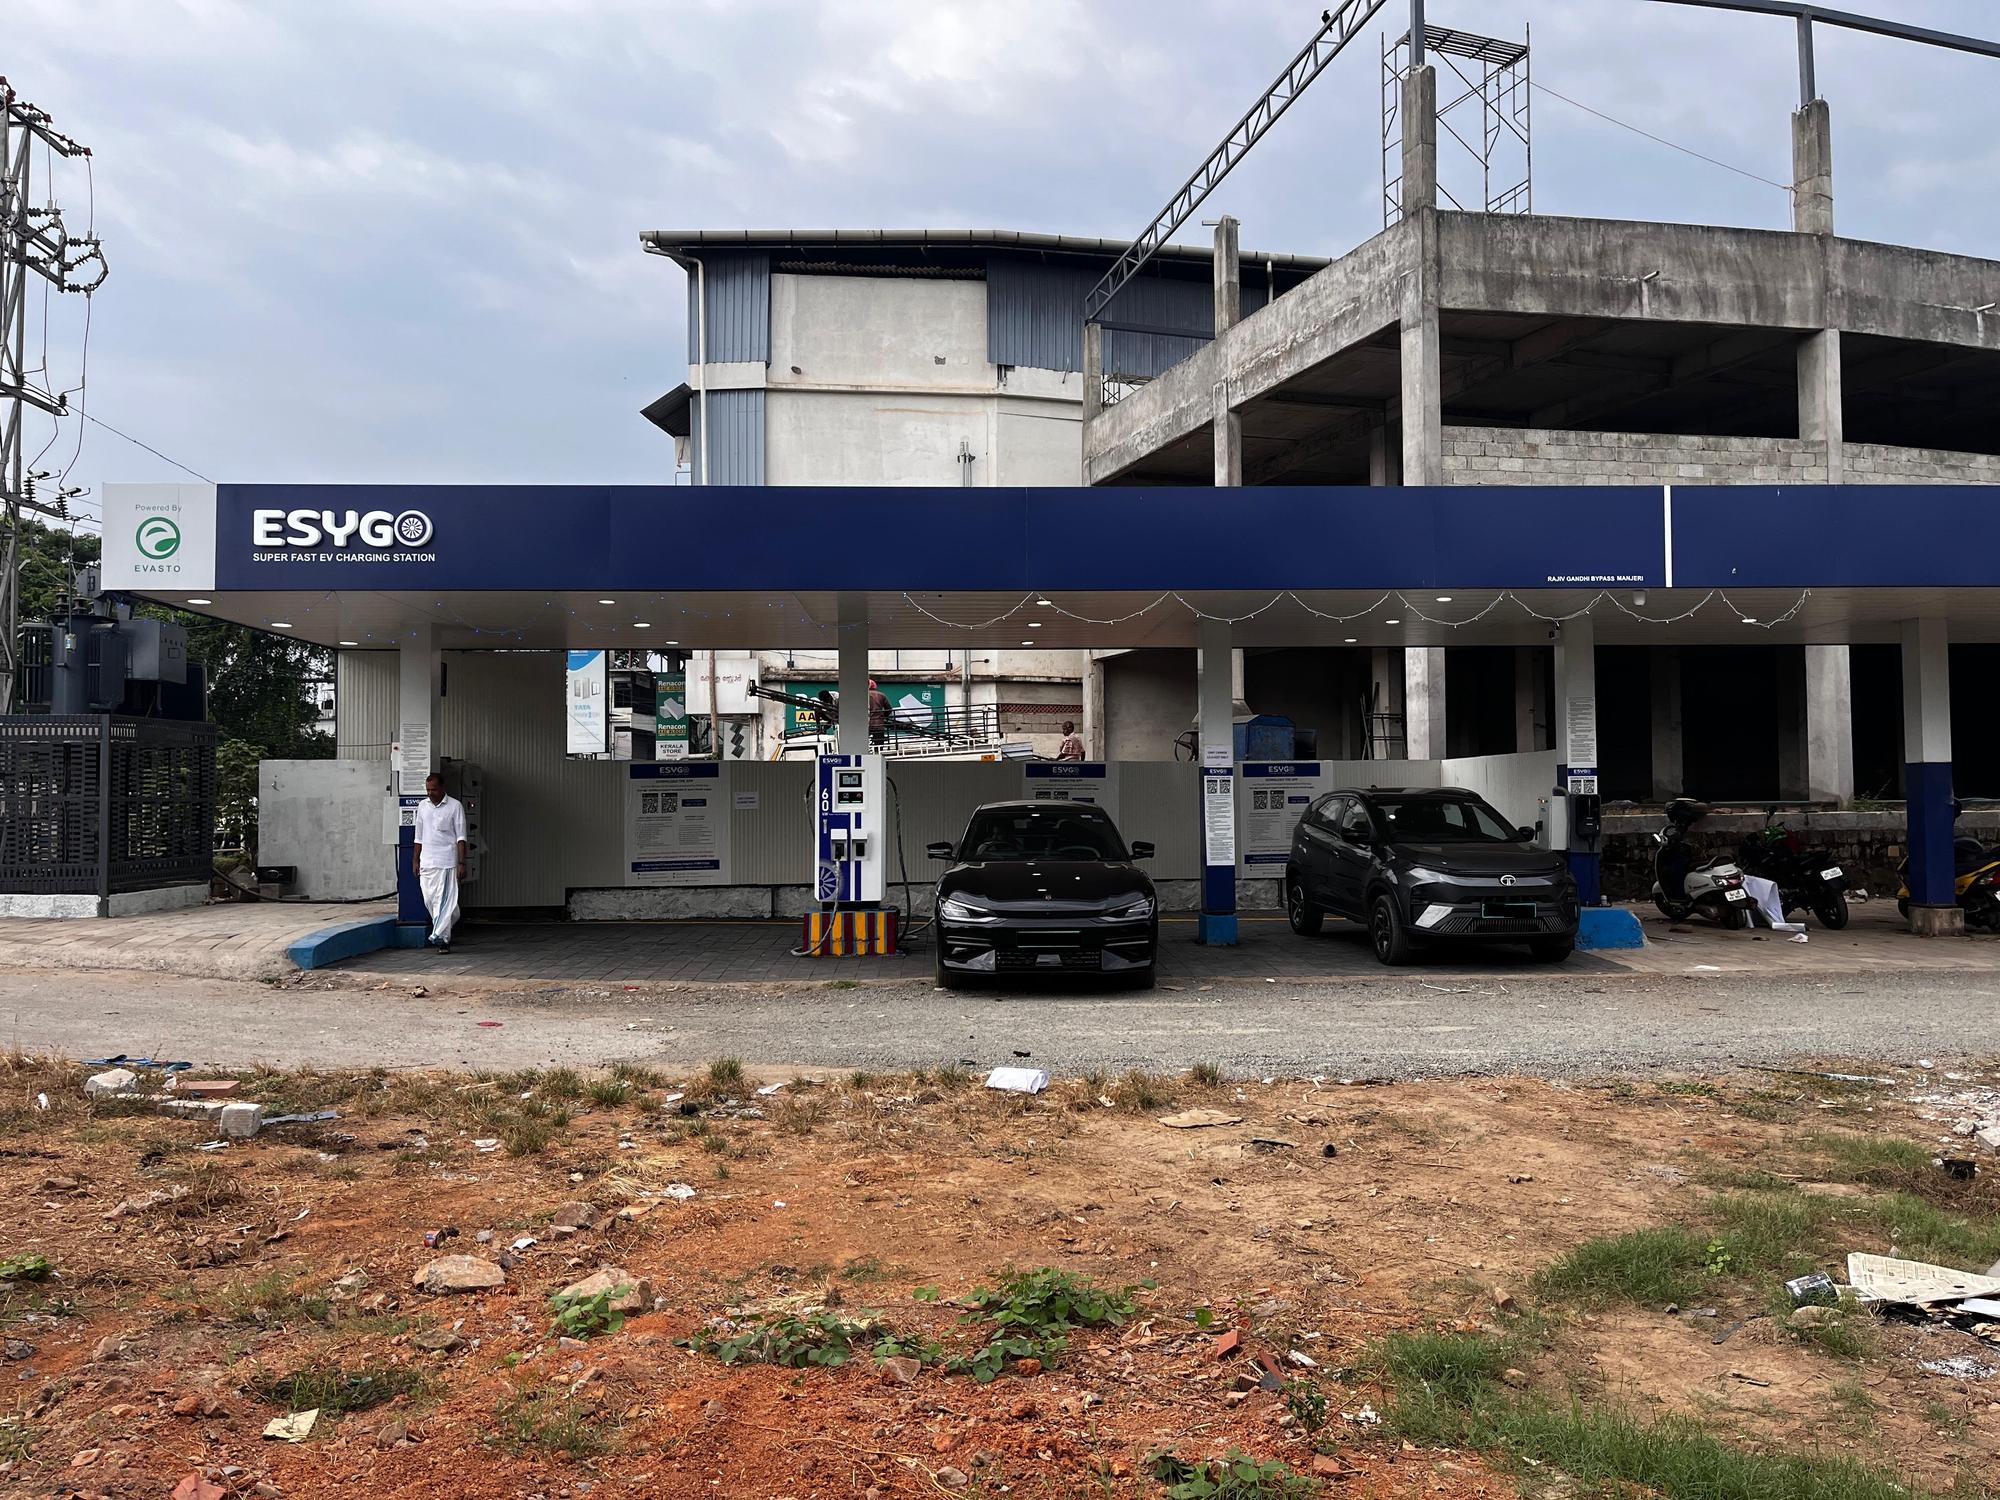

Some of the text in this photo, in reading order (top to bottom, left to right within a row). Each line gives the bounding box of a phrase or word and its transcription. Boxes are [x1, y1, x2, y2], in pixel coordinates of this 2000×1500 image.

[172, 504, 182, 512] By
[253, 509, 434, 547] ESYGO
[252, 553, 436, 562] SUPER FAST EV CHARGING STATION
[134, 564, 181, 572] EVASTO
